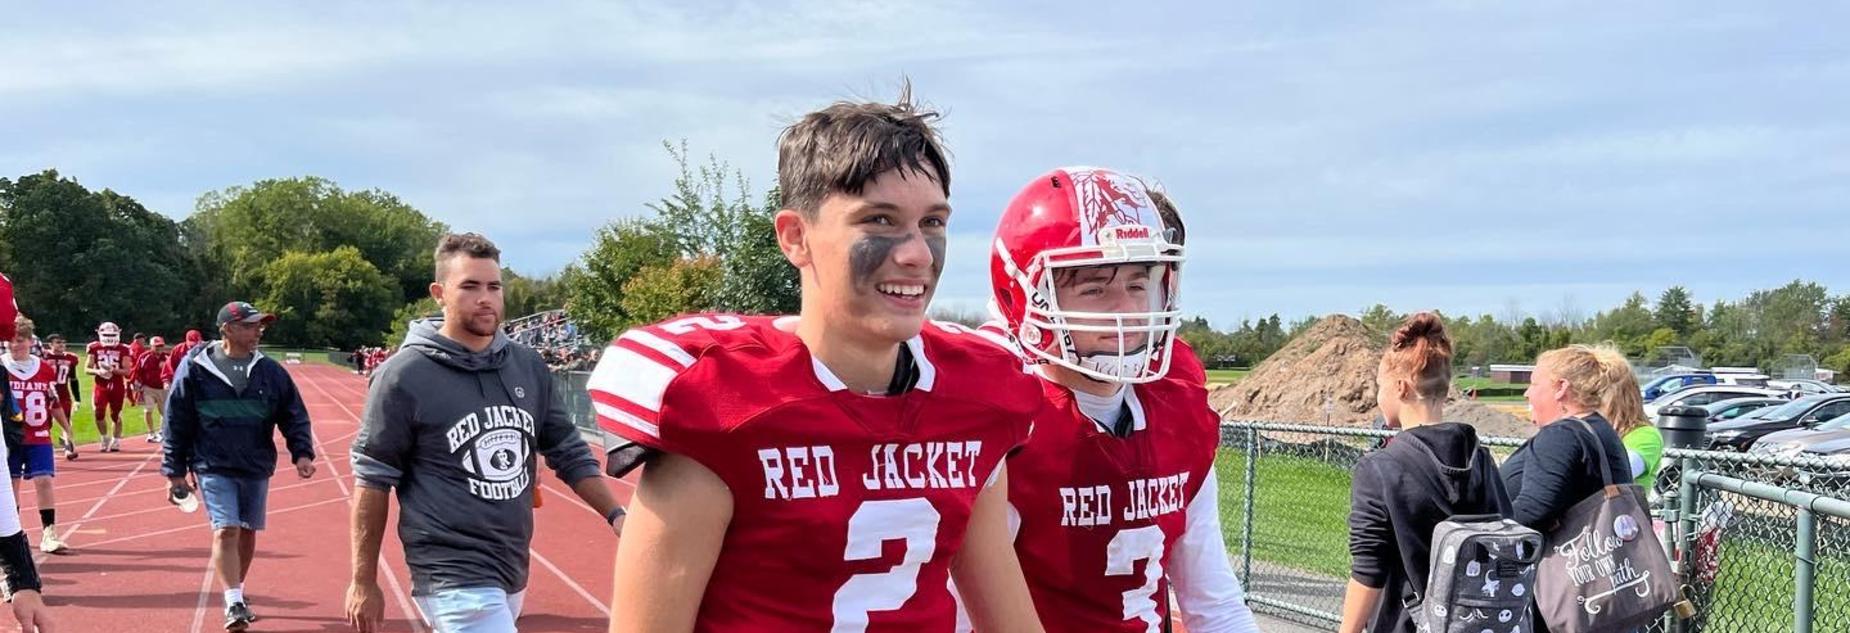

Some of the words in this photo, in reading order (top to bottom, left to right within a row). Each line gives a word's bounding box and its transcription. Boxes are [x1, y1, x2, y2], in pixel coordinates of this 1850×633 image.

[1115, 228, 1150, 239] Riddell
[446, 412, 480, 454] RED
[484, 405, 535, 437] JACKET
[467, 466, 530, 500] FOOTBALL
[758, 445, 839, 500] RED
[863, 440, 982, 490] JACKET
[1059, 485, 1112, 526] RED
[1123, 471, 1190, 521] JACKET
[830, 497, 941, 633] 2
[1105, 524, 1166, 633] 3
[1567, 564, 1596, 586] YOUR
